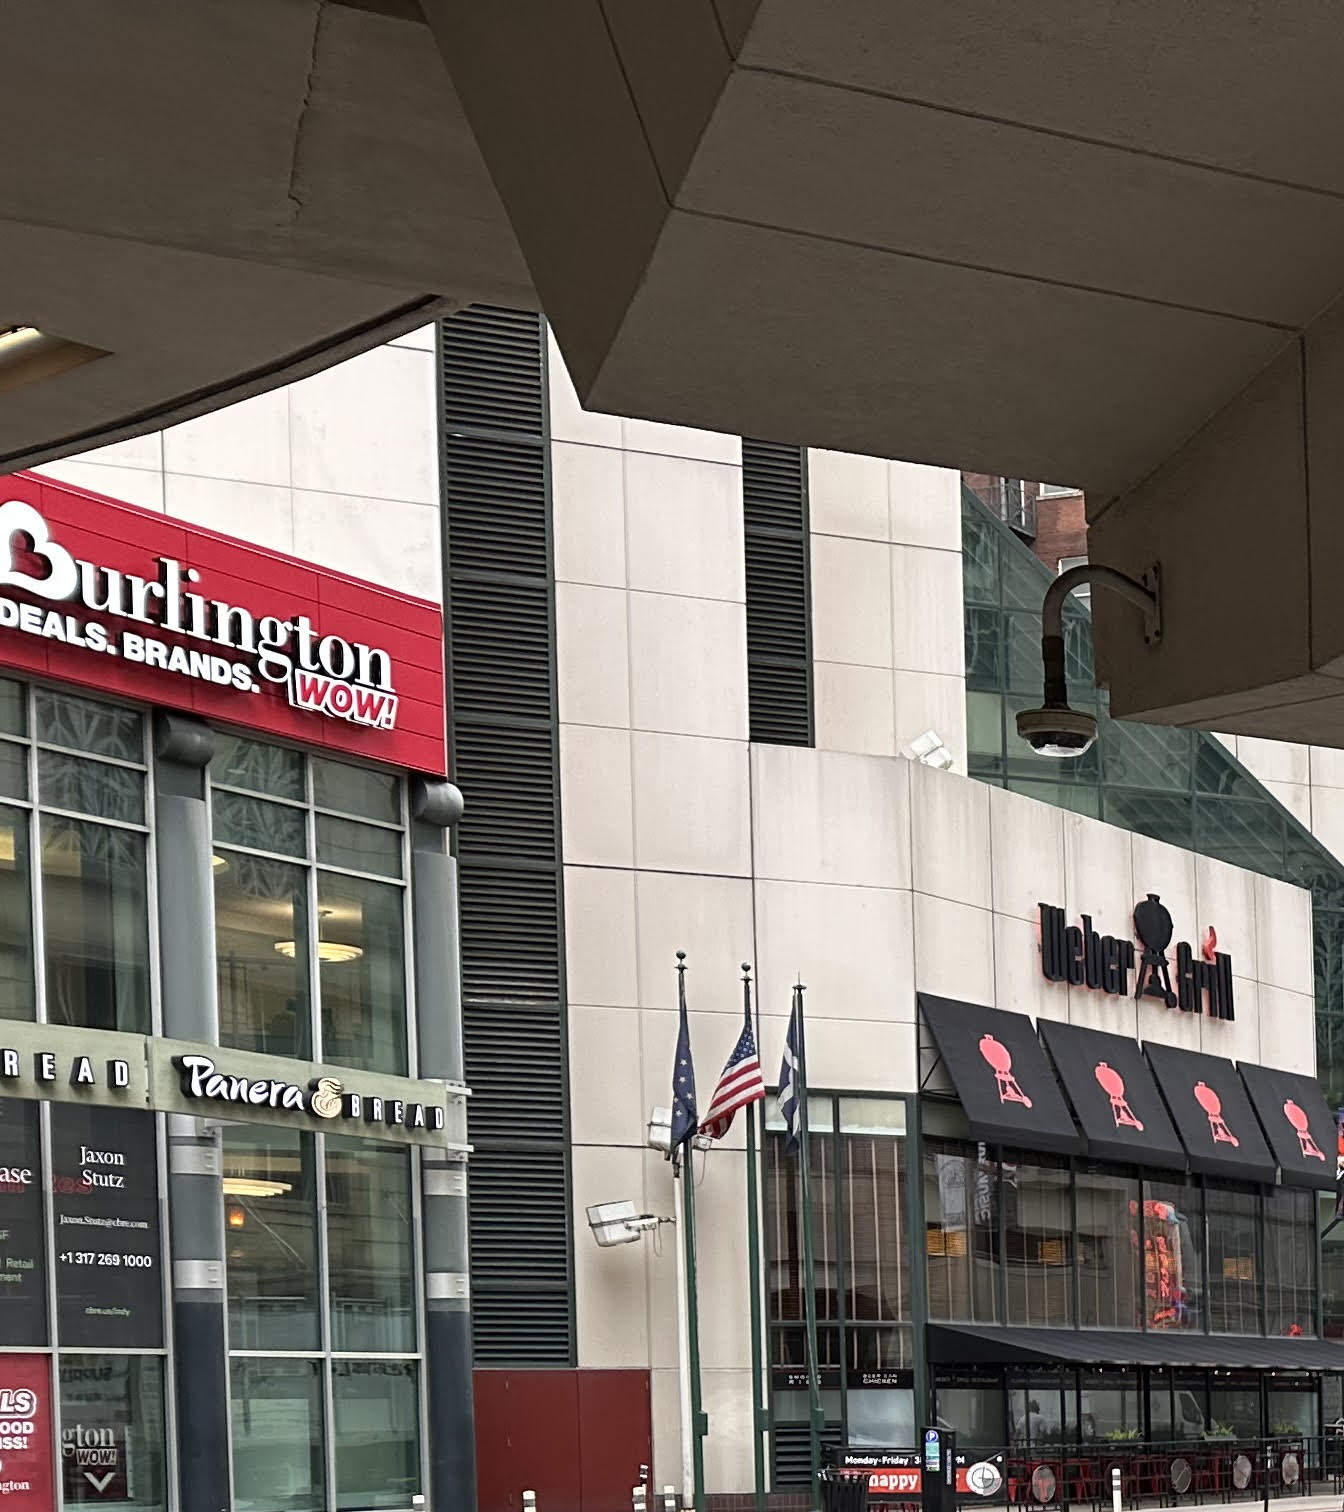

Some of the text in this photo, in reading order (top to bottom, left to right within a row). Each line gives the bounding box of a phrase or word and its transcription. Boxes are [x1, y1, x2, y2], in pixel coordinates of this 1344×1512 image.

[0, 500, 396, 692] Burlington
[0, 597, 260, 694] DEALS. BRANDS.
[296, 673, 396, 730] WOW!
[1037, 902, 1235, 1021] Weber Grill
[182, 1055, 445, 1129] Panera BREAD
[79, 1146, 125, 1166] Jaxon
[82, 1169, 125, 1189] Stutz
[59, 1252, 152, 1268] +1 317 269 1000
[77, 1450, 117, 1465] WOW!
